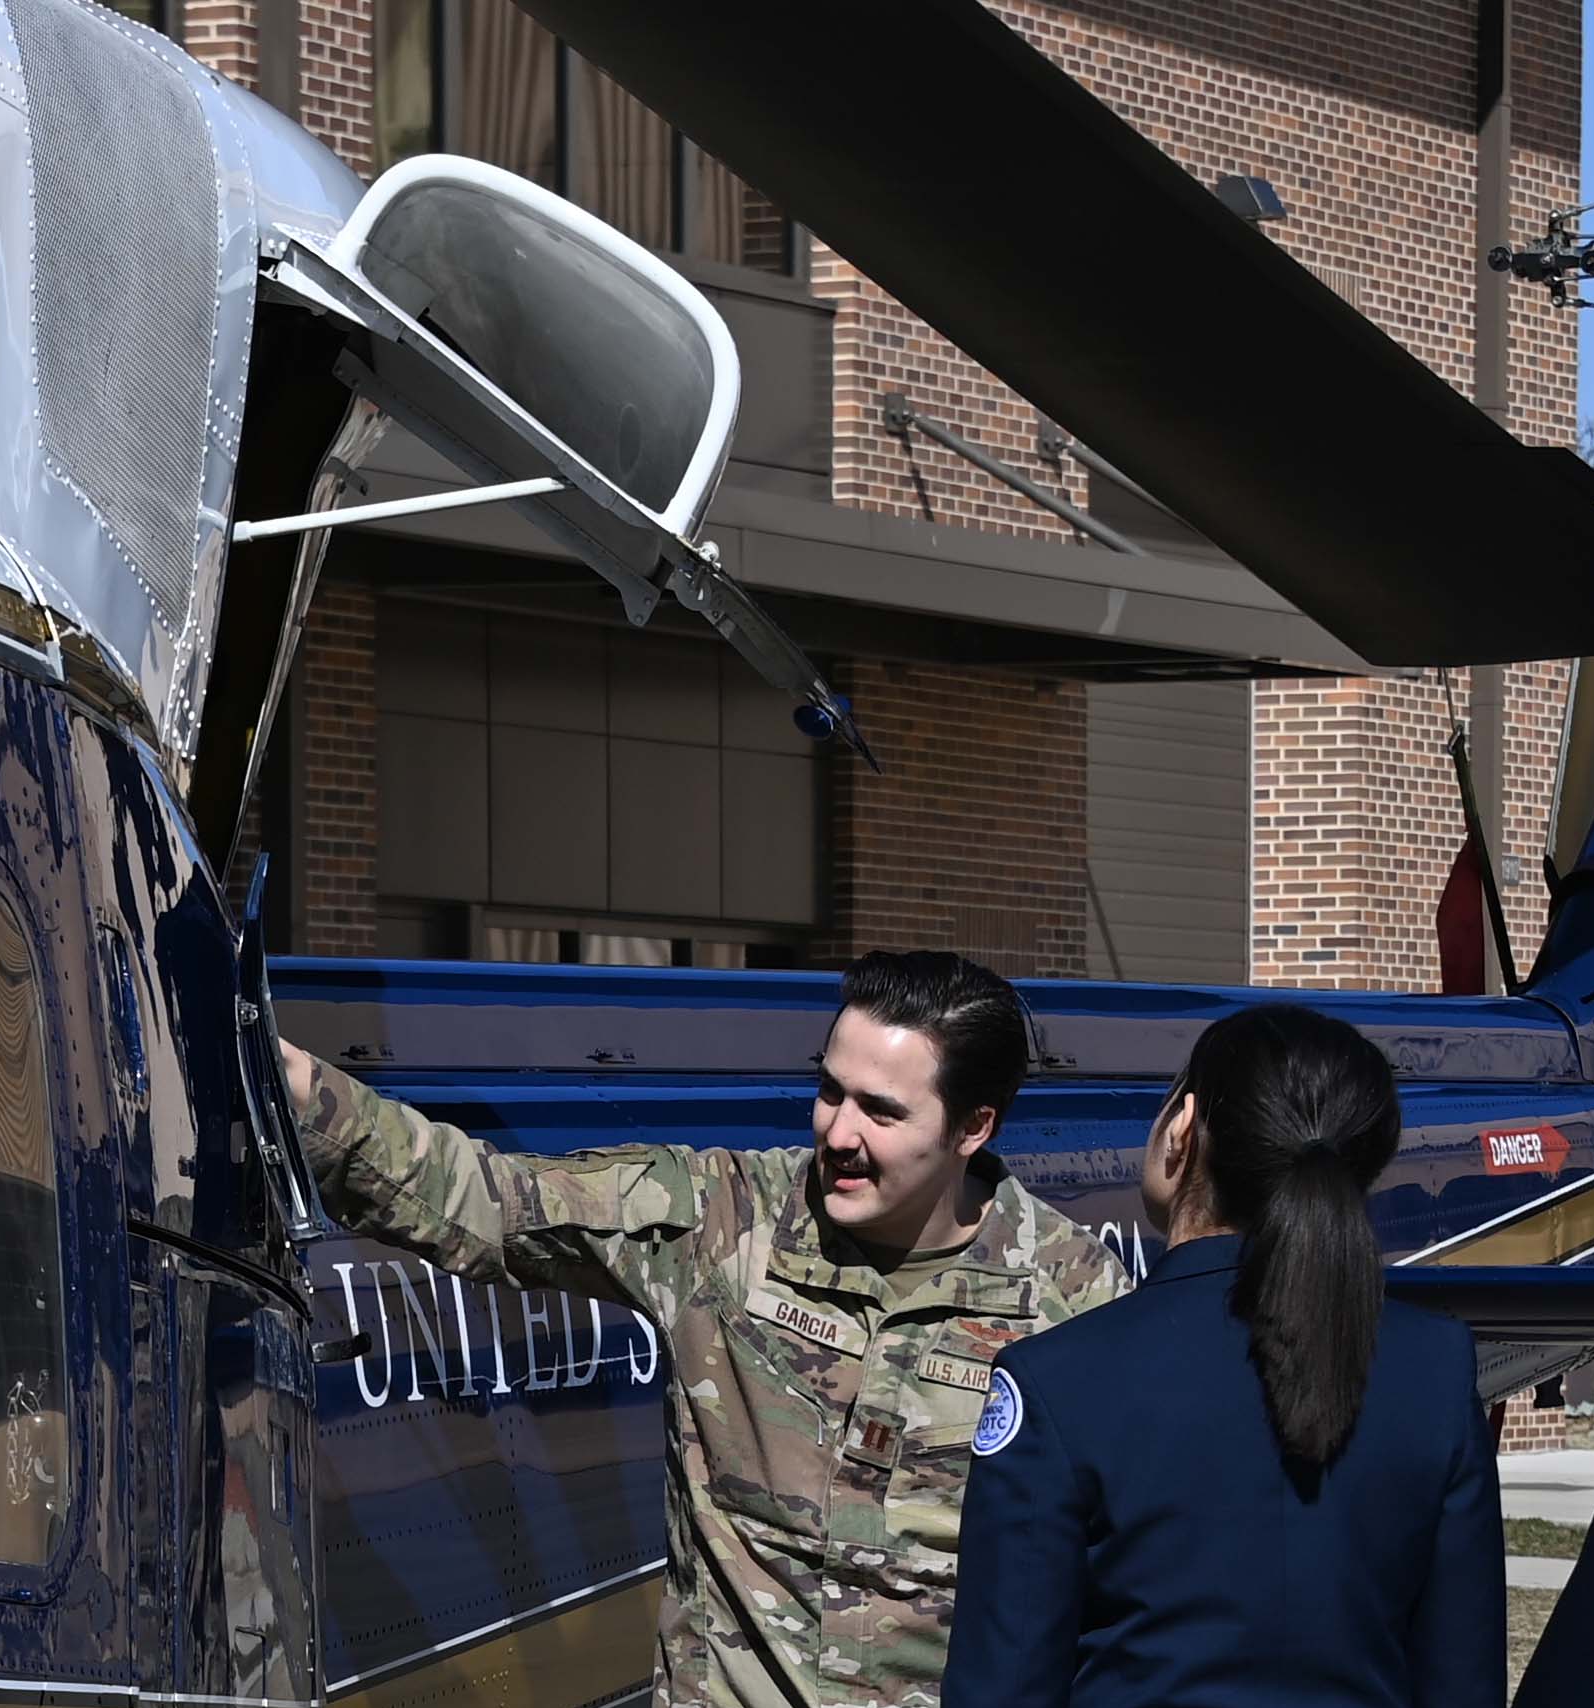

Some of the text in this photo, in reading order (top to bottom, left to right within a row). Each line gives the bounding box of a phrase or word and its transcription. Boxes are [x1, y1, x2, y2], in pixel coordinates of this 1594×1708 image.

[1488, 1132, 1544, 1167] DANGER
[775, 1302, 838, 1343] GARCIA
[926, 1359, 988, 1389] U.S. AIR
[979, 1416, 1007, 1430] OTC
